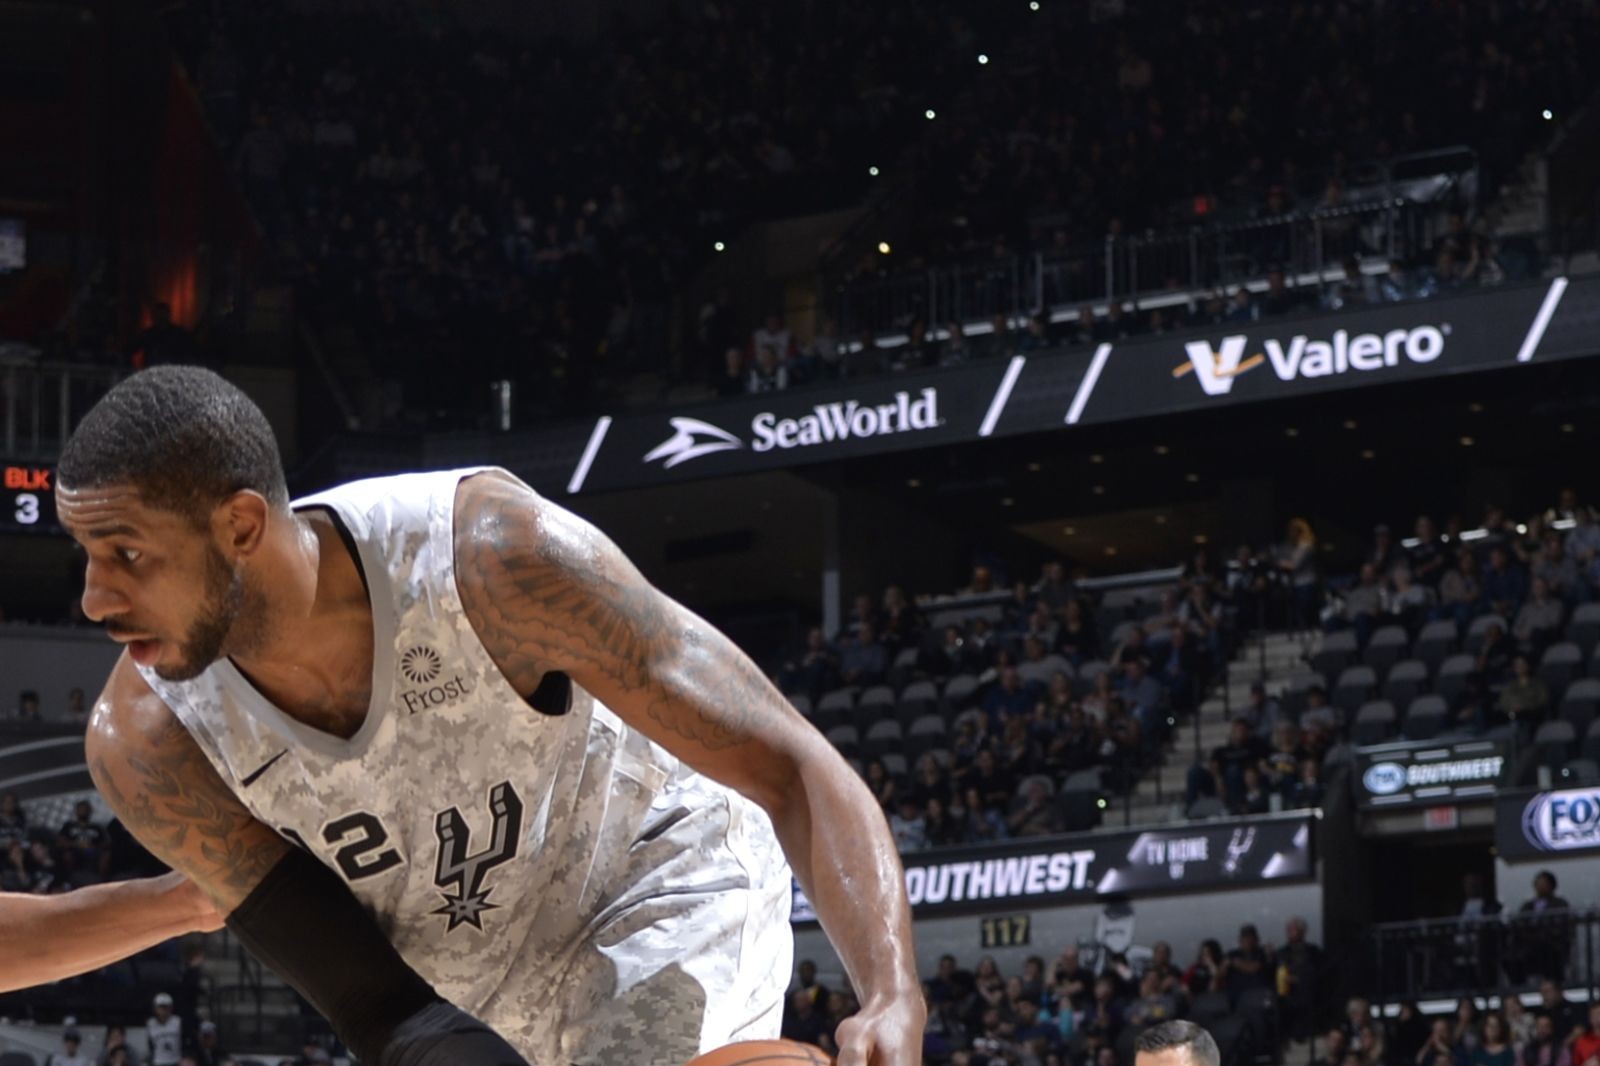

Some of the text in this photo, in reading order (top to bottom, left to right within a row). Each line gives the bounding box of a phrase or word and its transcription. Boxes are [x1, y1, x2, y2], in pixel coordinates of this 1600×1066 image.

[1264, 325, 1445, 381] Valero
[752, 387, 940, 452] SeaWorld
[4, 467, 50, 490] BLK
[15, 493, 40, 524] 3
[400, 674, 470, 716] Frost
[1406, 756, 1504, 786] SOUTHWEST
[905, 850, 1095, 906] OUTHWEST
[984, 917, 1027, 946] 117
